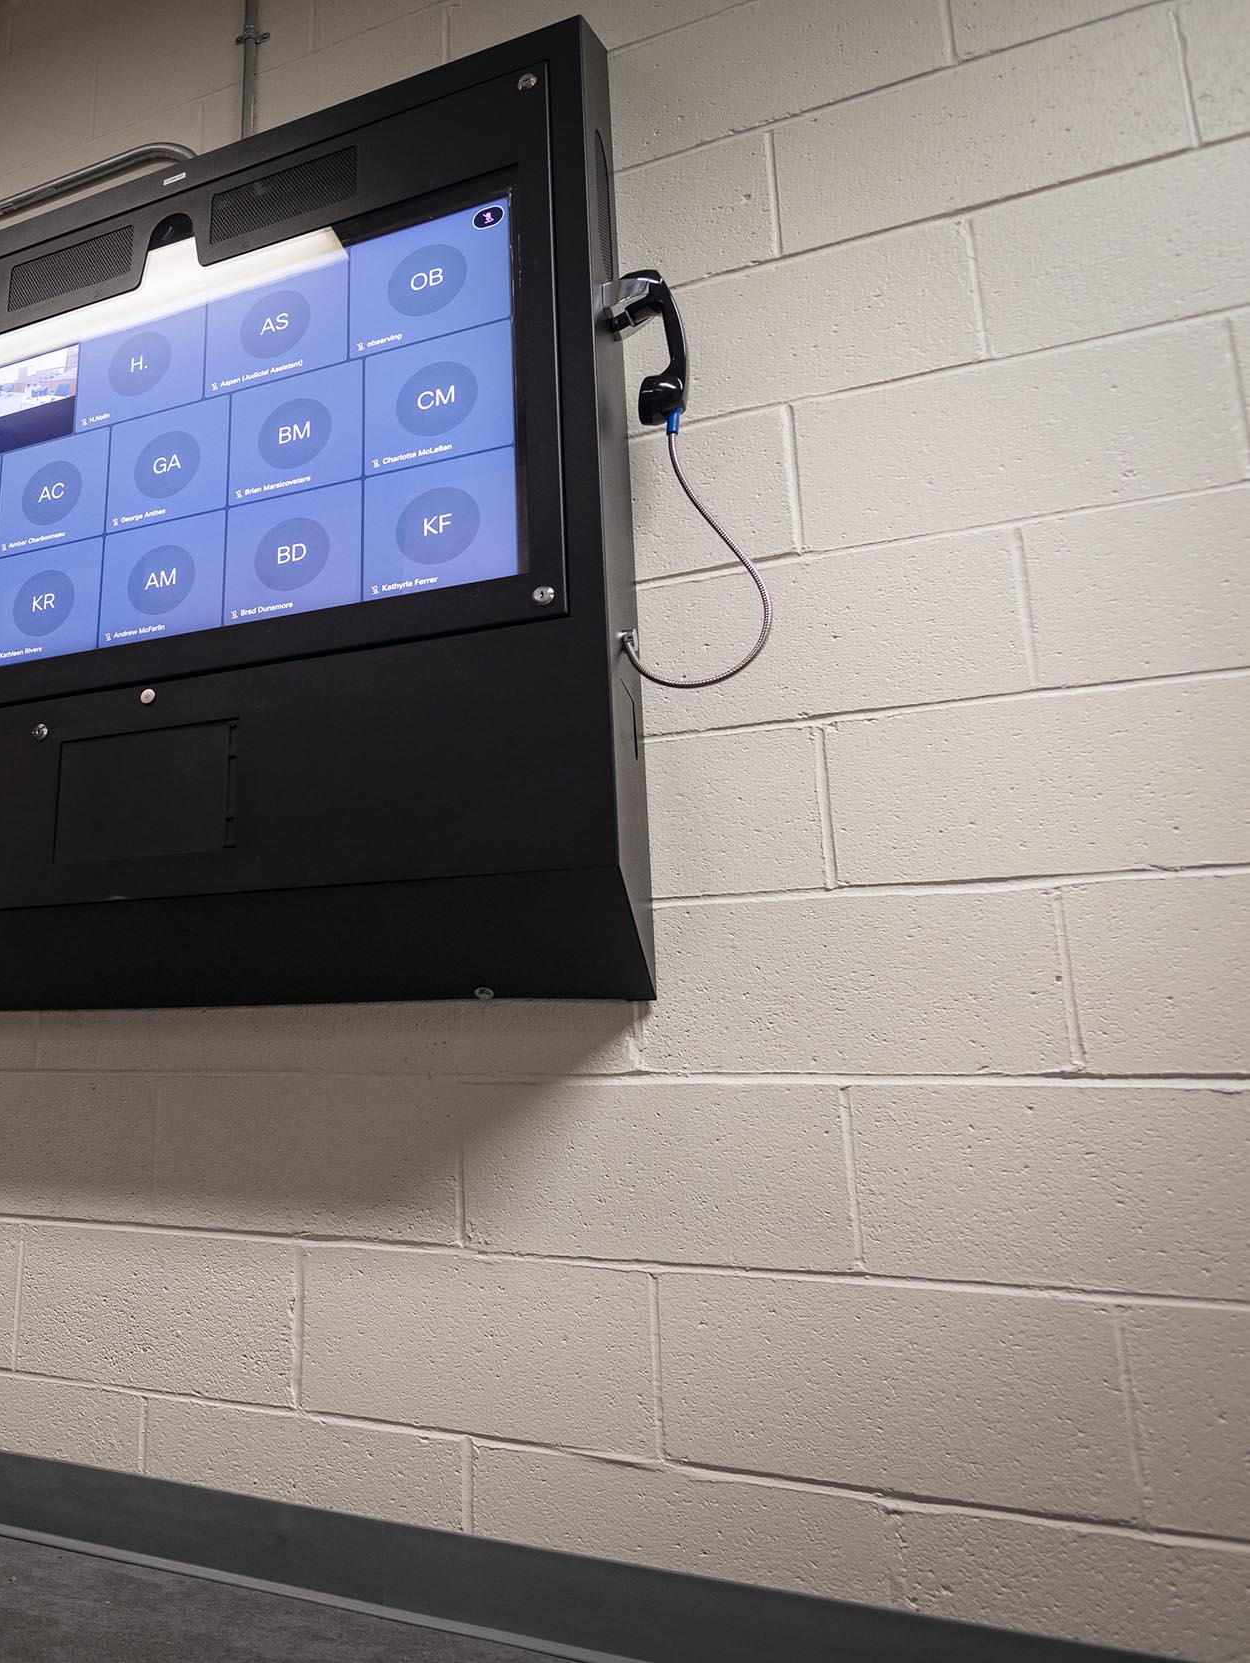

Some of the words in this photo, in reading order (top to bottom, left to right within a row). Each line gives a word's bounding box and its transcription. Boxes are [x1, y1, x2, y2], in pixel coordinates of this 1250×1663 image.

[411, 268, 443, 290] OB
[261, 313, 288, 335] AS
[366, 333, 403, 348] observing
[131, 355, 147, 372] H.
[418, 385, 454, 409] CM
[279, 421, 310, 444] BM
[153, 454, 181, 474] GA
[382, 451, 417, 465] Charlotte
[38, 483, 64, 502] AC
[244, 487, 263, 496] Brian
[120, 513, 144, 524] George
[424, 513, 451, 536] KF
[8, 537, 29, 549] Amber
[278, 543, 306, 564] BD
[145, 568, 176, 590] AM
[33, 593, 55, 612] KR
[240, 606, 257, 617] Brad
[257, 602, 294, 614] Dunsmore
[113, 629, 138, 639] Andrew
[21, 646, 43, 655] Rivers
